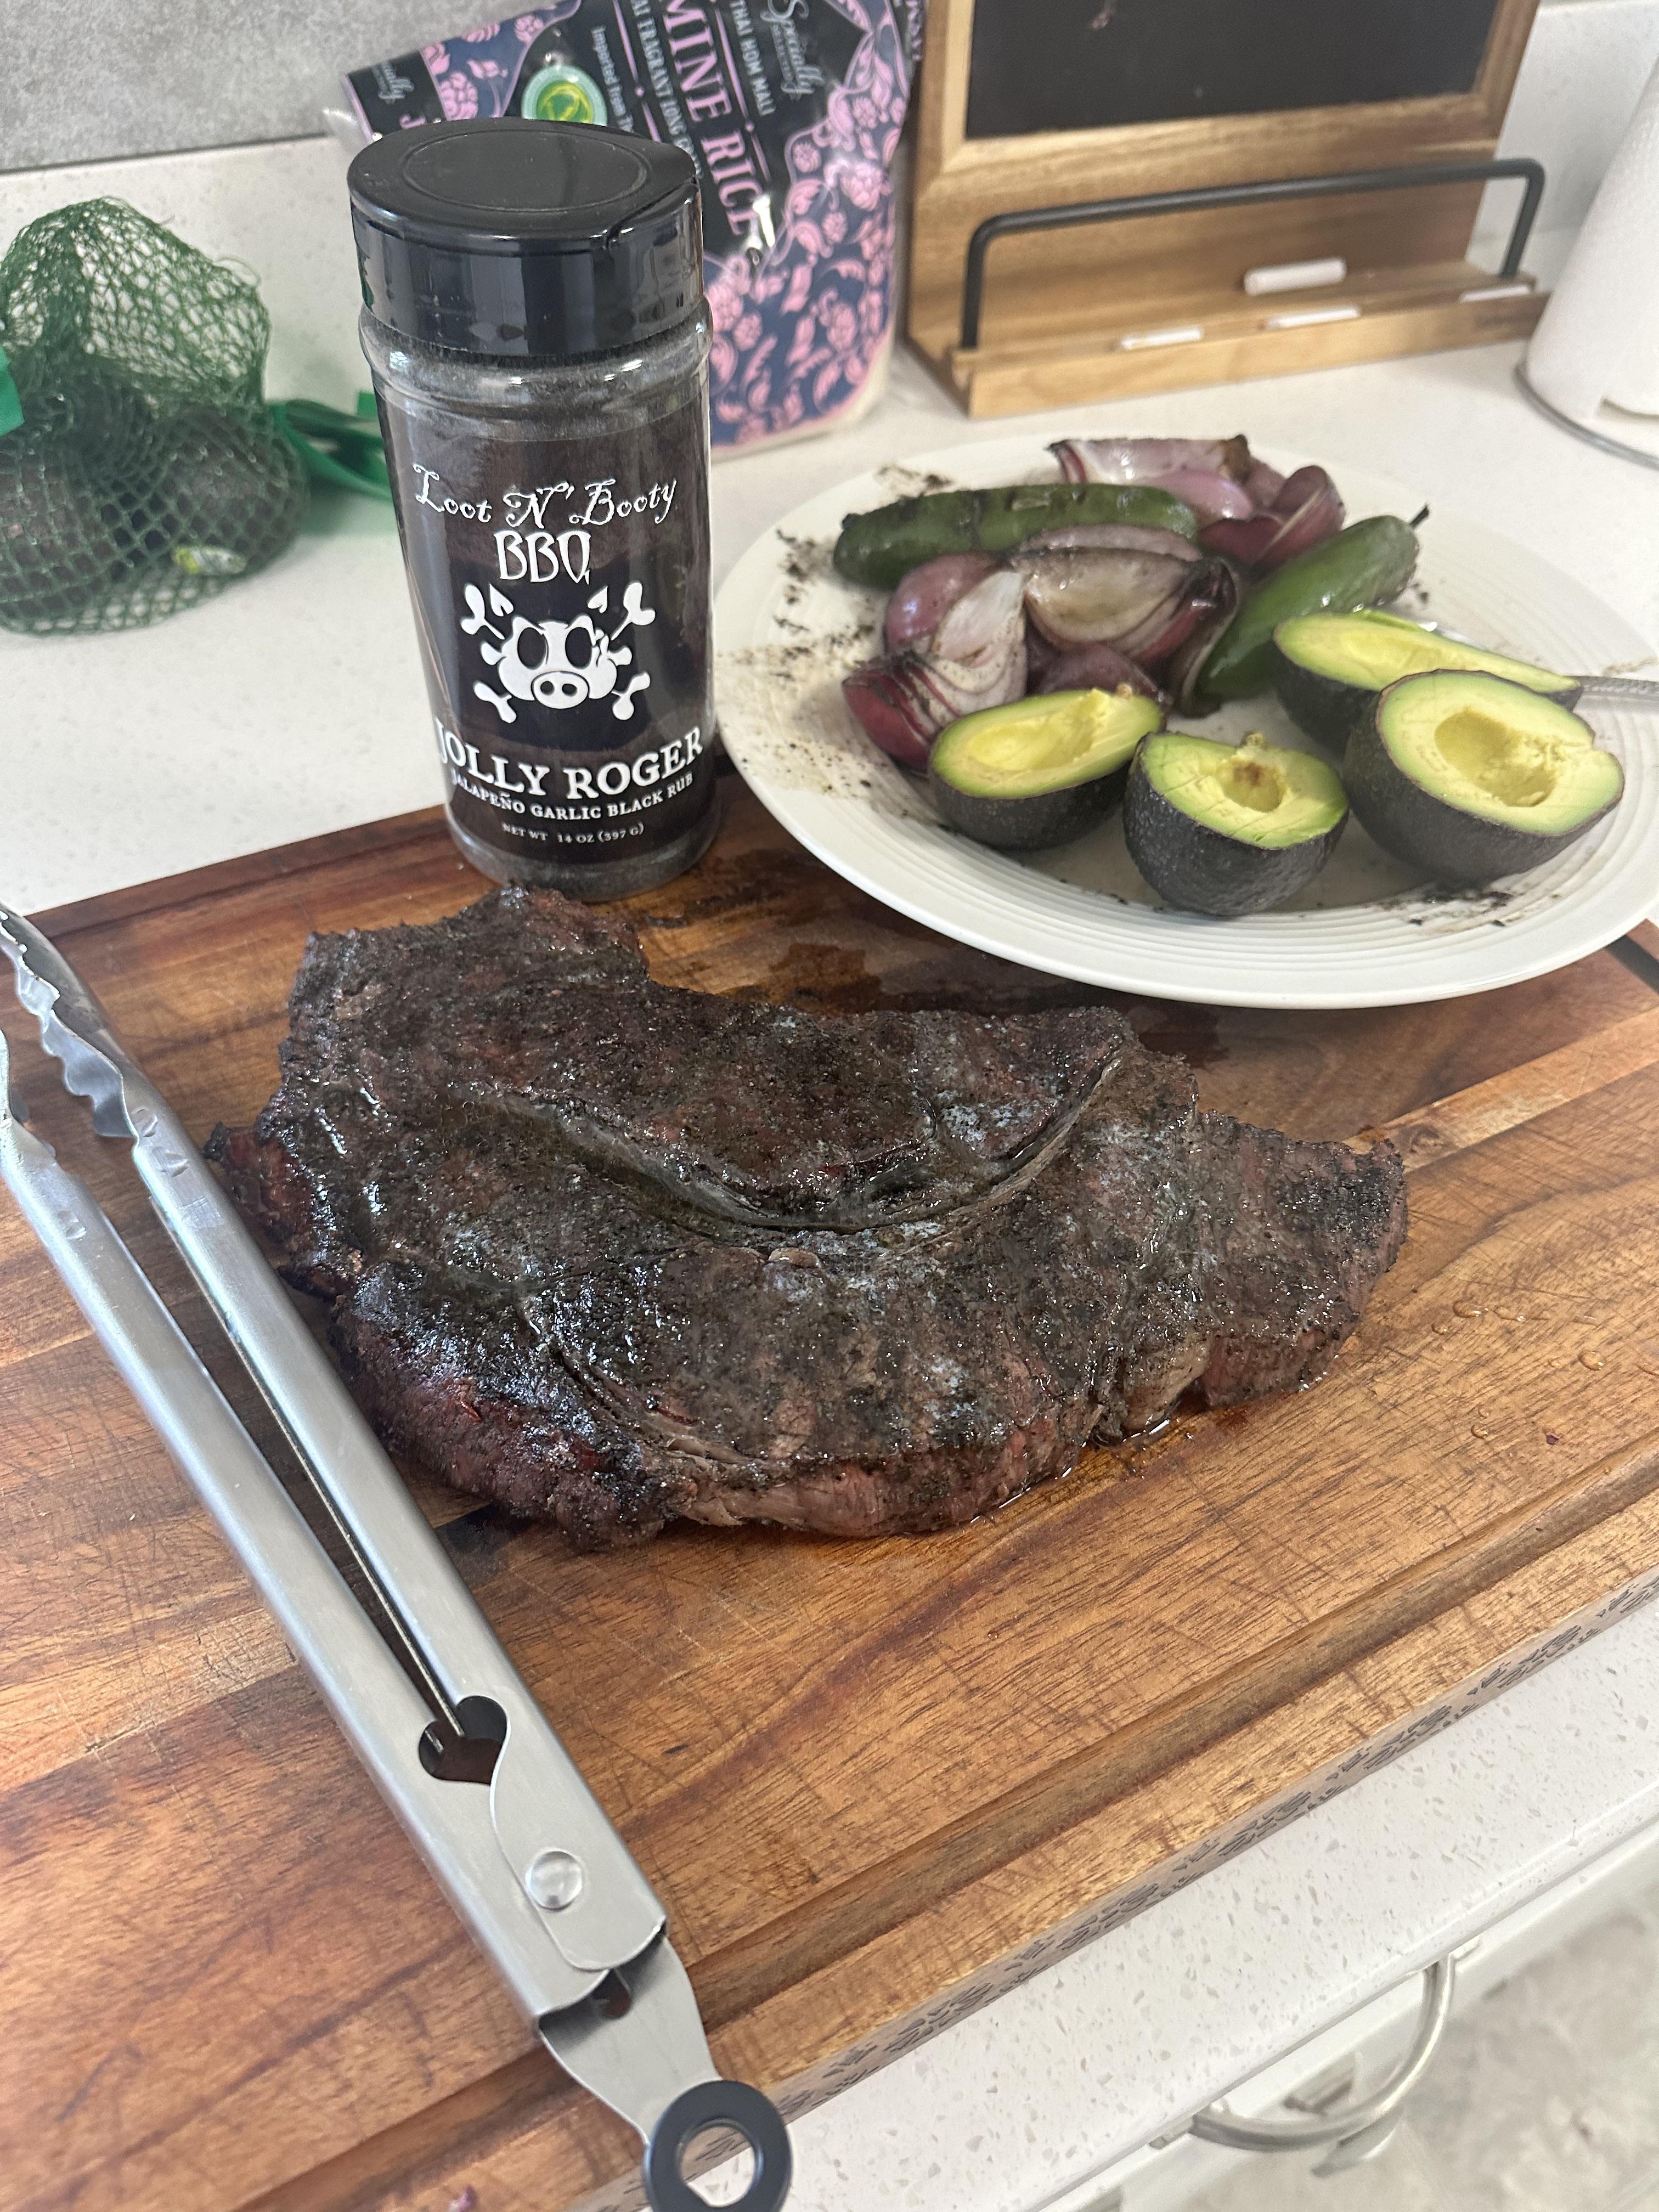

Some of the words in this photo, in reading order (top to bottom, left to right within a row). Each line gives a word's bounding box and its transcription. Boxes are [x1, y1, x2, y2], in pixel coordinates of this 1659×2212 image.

[730, 0, 754, 36] THAI
[760, 0, 824, 94] Specially
[590, 25, 620, 86] Imported
[608, 84, 627, 117] from
[636, 17, 674, 98] FRAGRANT
[659, 98, 687, 136] LONG
[741, 37, 765, 76] HOM
[751, 76, 777, 117] MALI
[700, 131, 766, 236] RICE
[413, 464, 493, 523] Loot
[568, 478, 678, 526] Booty
[493, 529, 592, 585] BBQ
[435, 715, 550, 795] JOLLY
[562, 726, 704, 799] ROGER
[450, 767, 526, 814] JALAPEÑO
[529, 803, 601, 821] GARLIC
[606, 789, 664, 817] BLACK
[667, 771, 693, 799] RUB
[501, 822, 527, 837] NET
[528, 830, 549, 842] WT
[557, 833, 573, 843] 14
[575, 833, 595, 843] OZ
[597, 830, 627, 843] (397
[629, 822, 645, 836] G)
